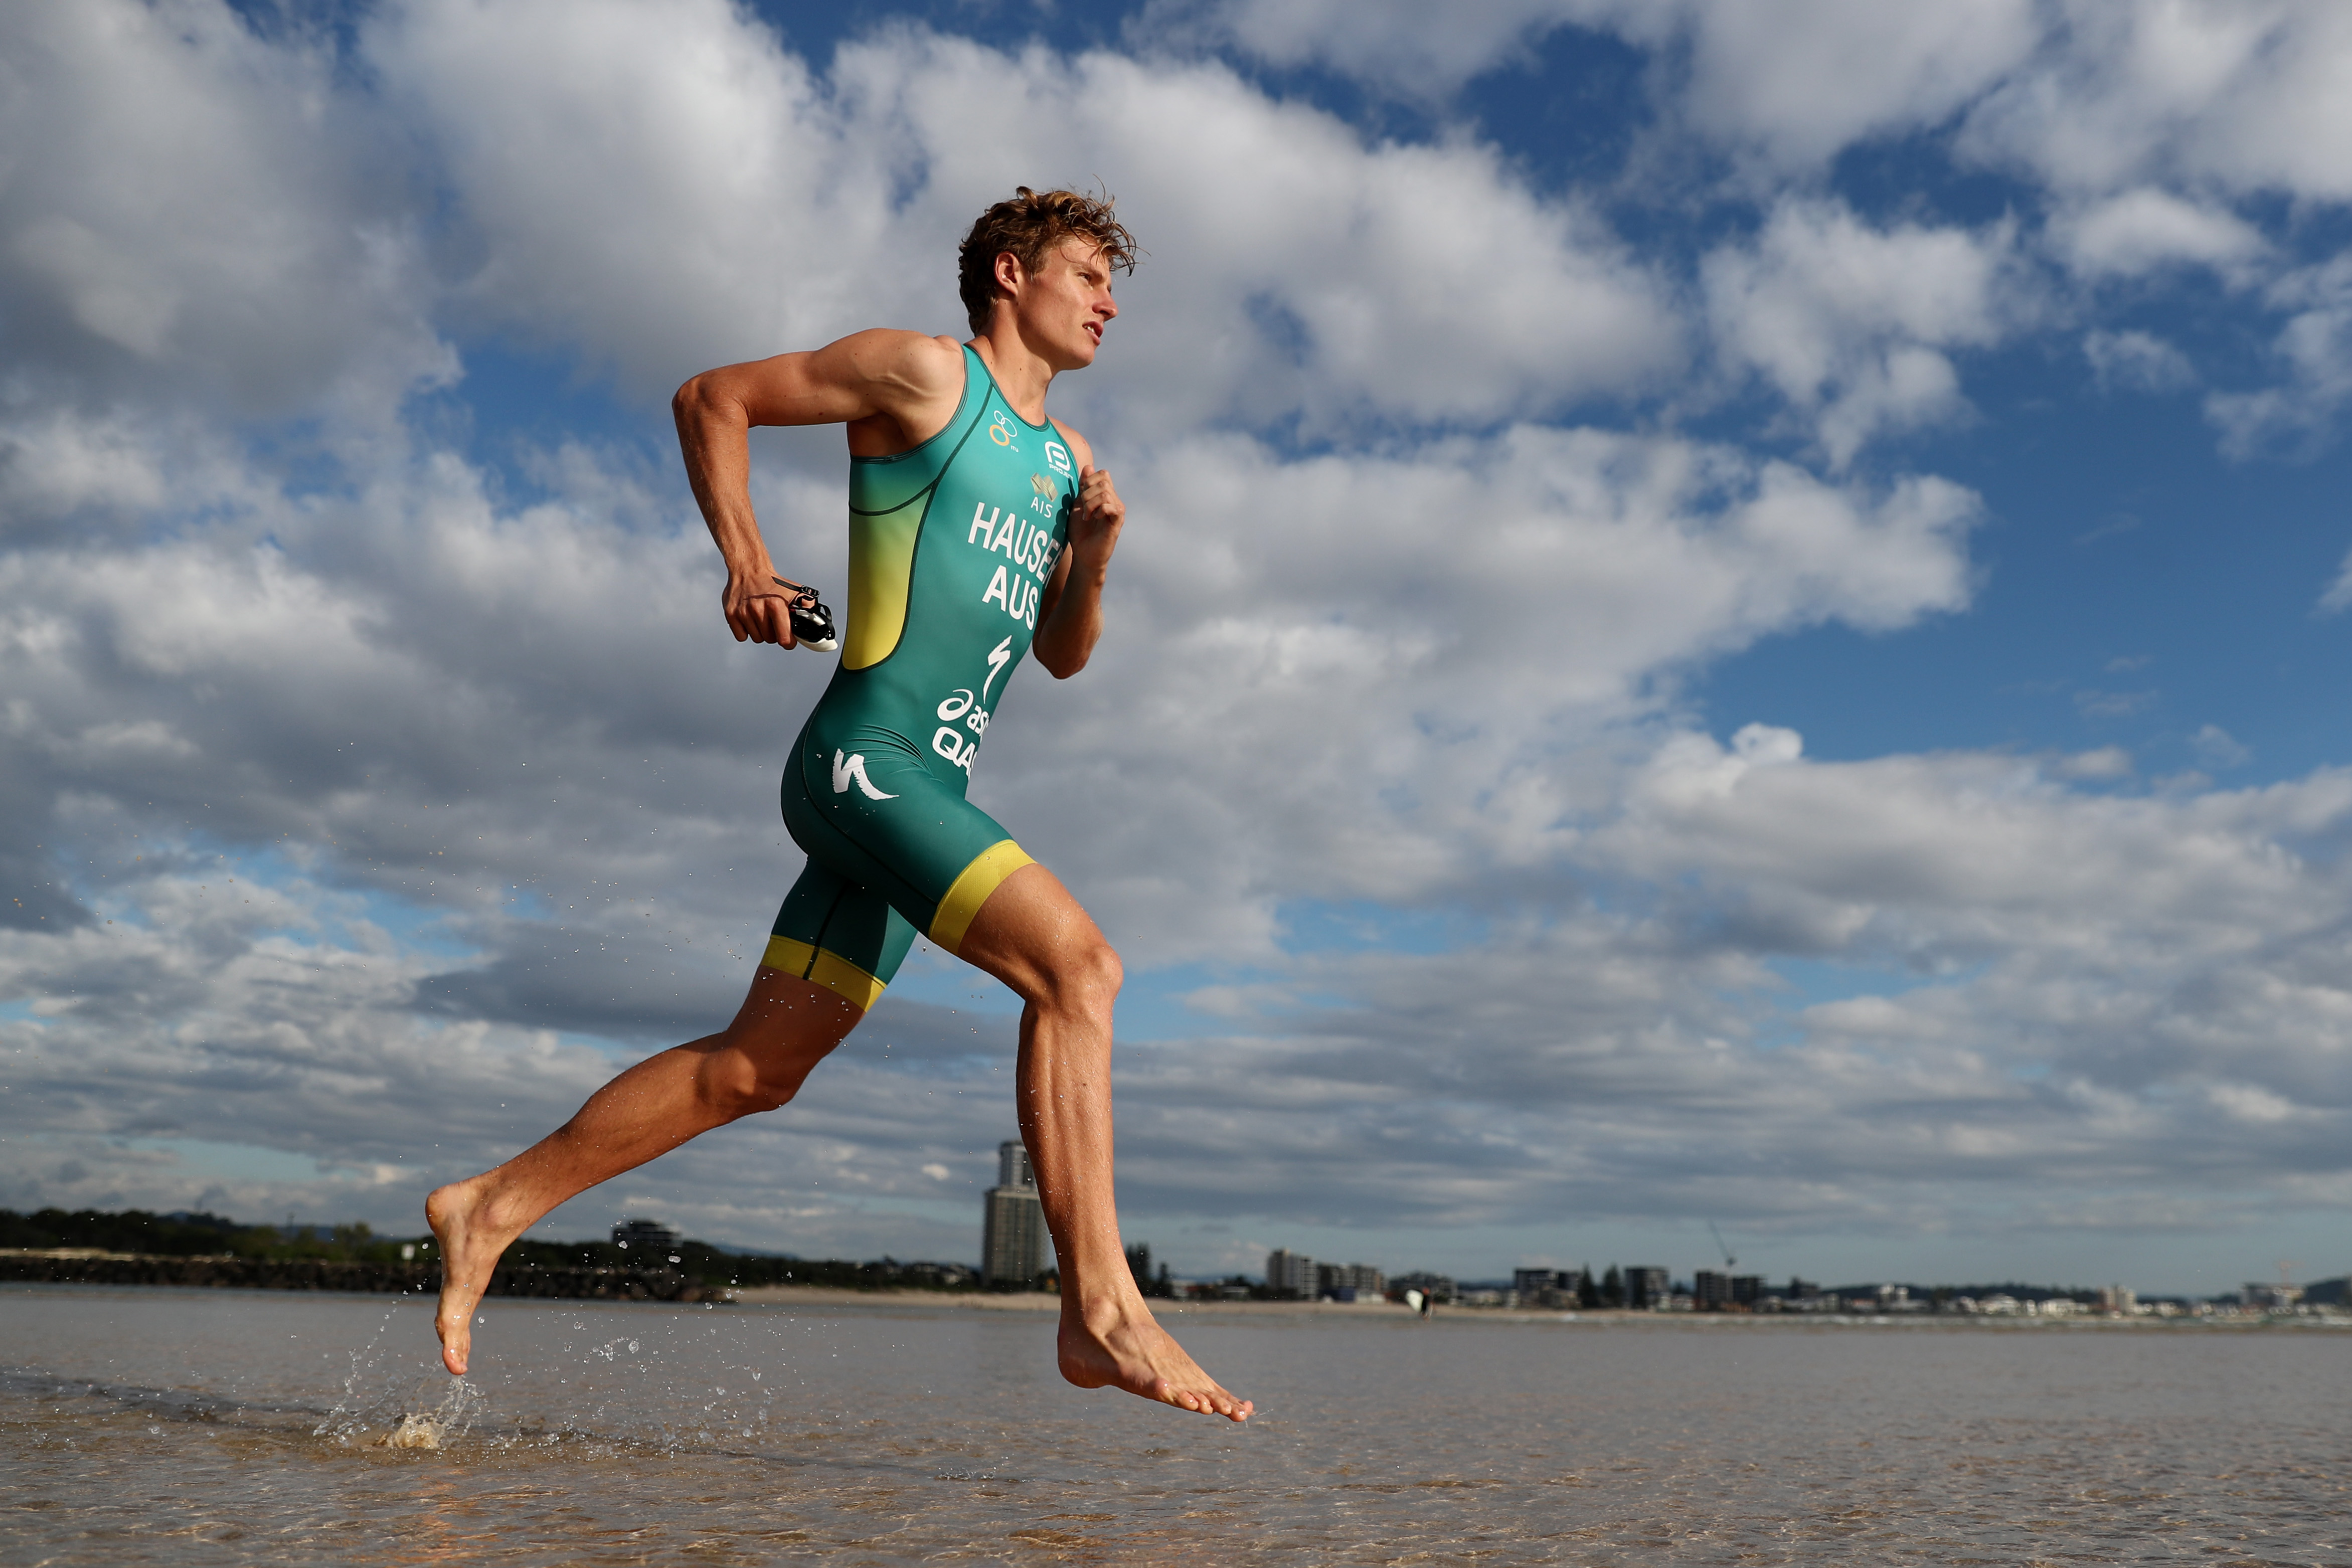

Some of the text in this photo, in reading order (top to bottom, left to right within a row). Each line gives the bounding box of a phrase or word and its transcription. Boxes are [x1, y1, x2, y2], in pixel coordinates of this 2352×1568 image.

[1031, 496, 1053, 518] AIS
[968, 502, 1063, 589] HAUSER
[982, 565, 1038, 630] AUS
[932, 727, 977, 781] QA
